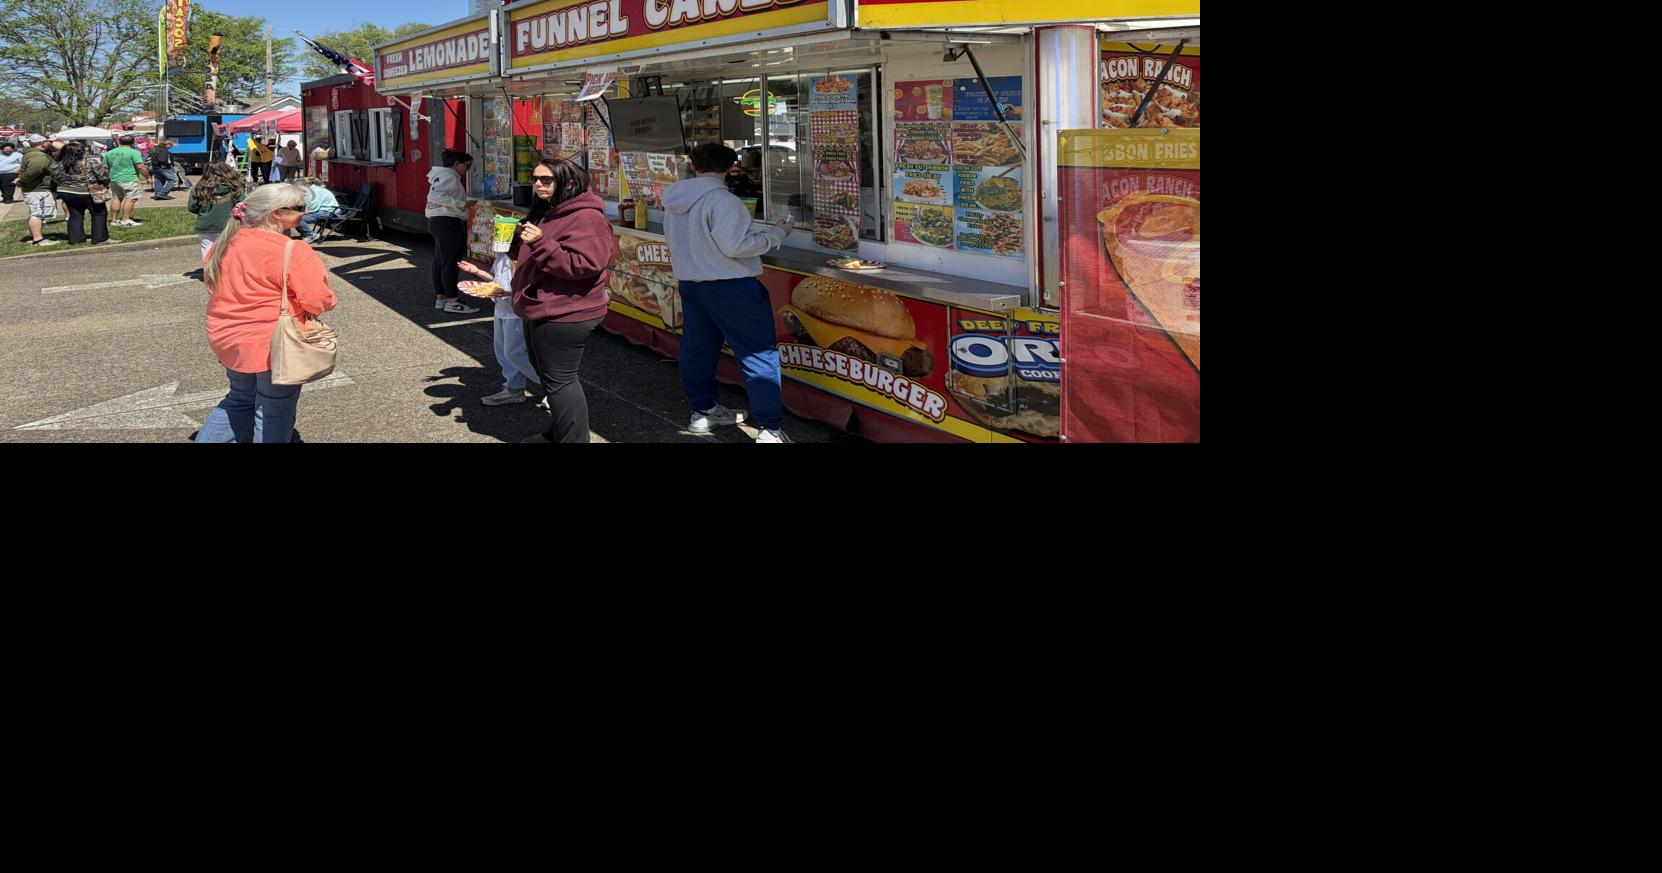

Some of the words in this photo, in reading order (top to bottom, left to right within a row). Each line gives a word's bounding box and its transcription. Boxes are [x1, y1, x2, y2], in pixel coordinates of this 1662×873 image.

[517, 4, 627, 54] FUNNEL
[386, 52, 402, 64] FRESH
[408, 31, 490, 72] LEMONADE
[383, 65, 408, 78] SQUEEZED
[1145, 60, 1191, 87] RANCH
[1155, 143, 1198, 160] FRIES
[1146, 175, 1193, 198] RANCH
[637, 244, 672, 263] CHEE
[952, 335, 1060, 372] OR
[778, 345, 947, 420] CHEESEBURGER
